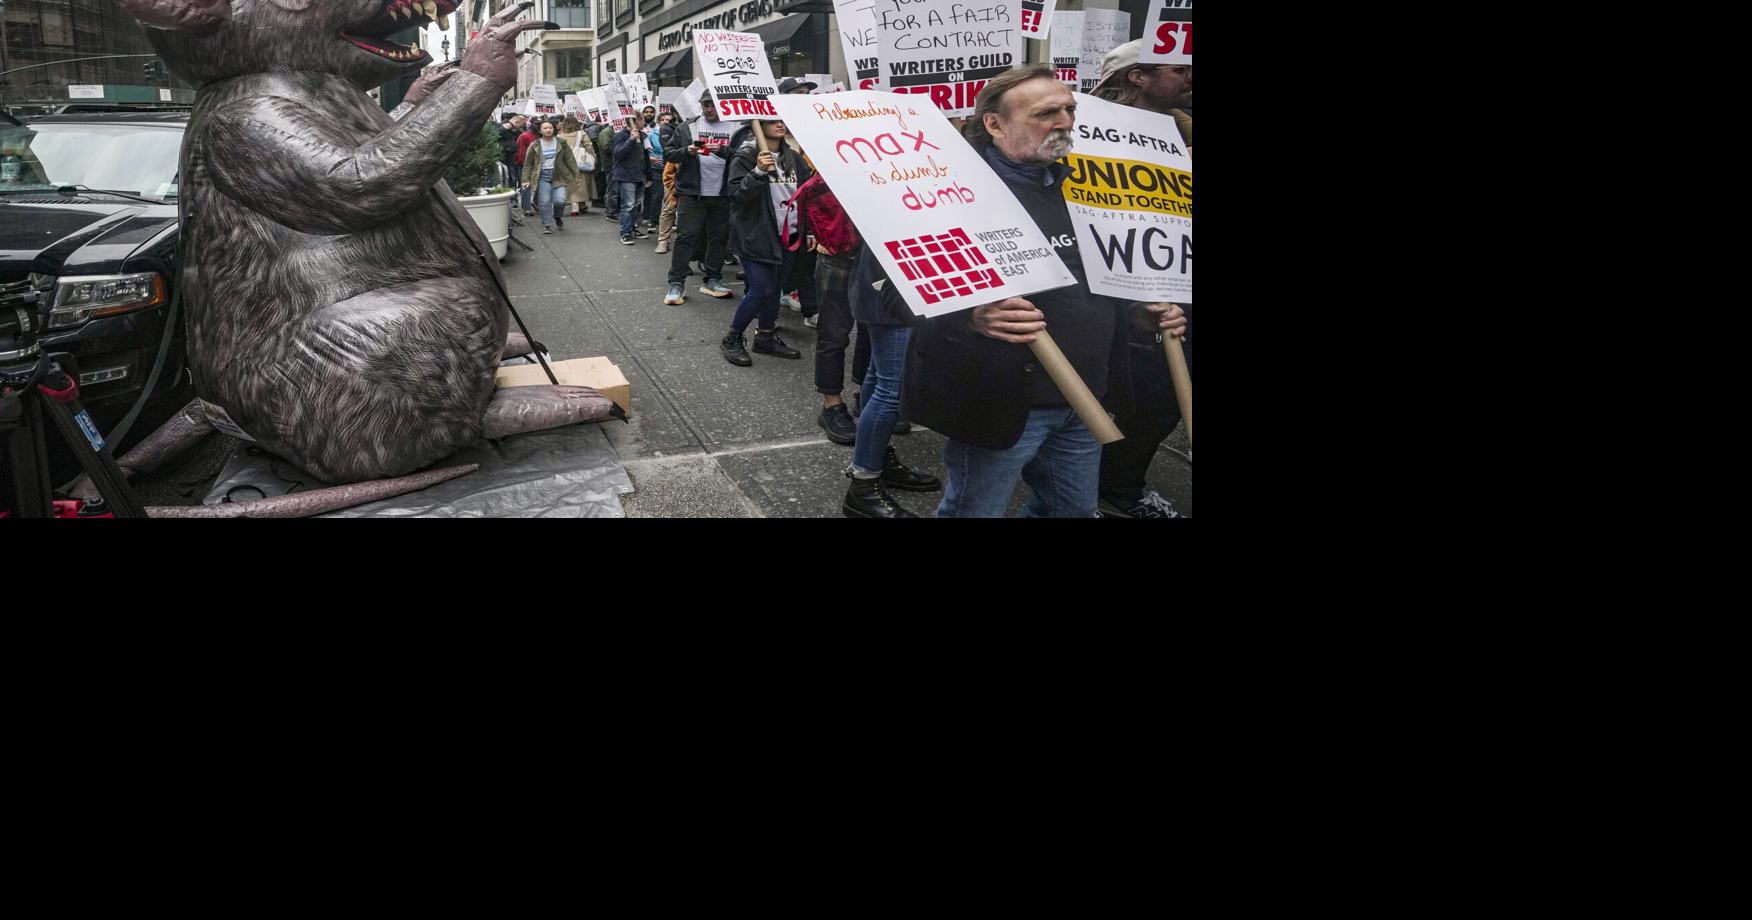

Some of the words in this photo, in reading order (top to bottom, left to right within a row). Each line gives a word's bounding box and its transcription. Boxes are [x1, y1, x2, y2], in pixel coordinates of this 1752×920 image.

[721, 8, 738, 30] OF
[878, 10, 921, 30] FOR
[928, 10, 943, 26] A
[949, 4, 1010, 24] FAIR
[699, 33, 714, 44] NO
[894, 29, 1014, 50] CONTRACT
[704, 44, 718, 53] NO
[889, 57, 964, 76] WRITERS
[968, 53, 1013, 69] GUILD
[948, 72, 964, 82] ON
[1081, 79, 1102, 88] WRIT
[714, 84, 752, 94] WRITERS
[752, 86, 775, 95] GUILD
[813, 101, 907, 130] Rebranding
[890, 155, 949, 182] dumb
[901, 181, 976, 211] dumb
[1070, 187, 1122, 206] STAND
[975, 227, 1024, 242] WRITERS
[984, 241, 1018, 254] GUILD
[994, 254, 1005, 265] of
[1006, 247, 1053, 263] AMERICA
[1002, 264, 1029, 277] EAST
